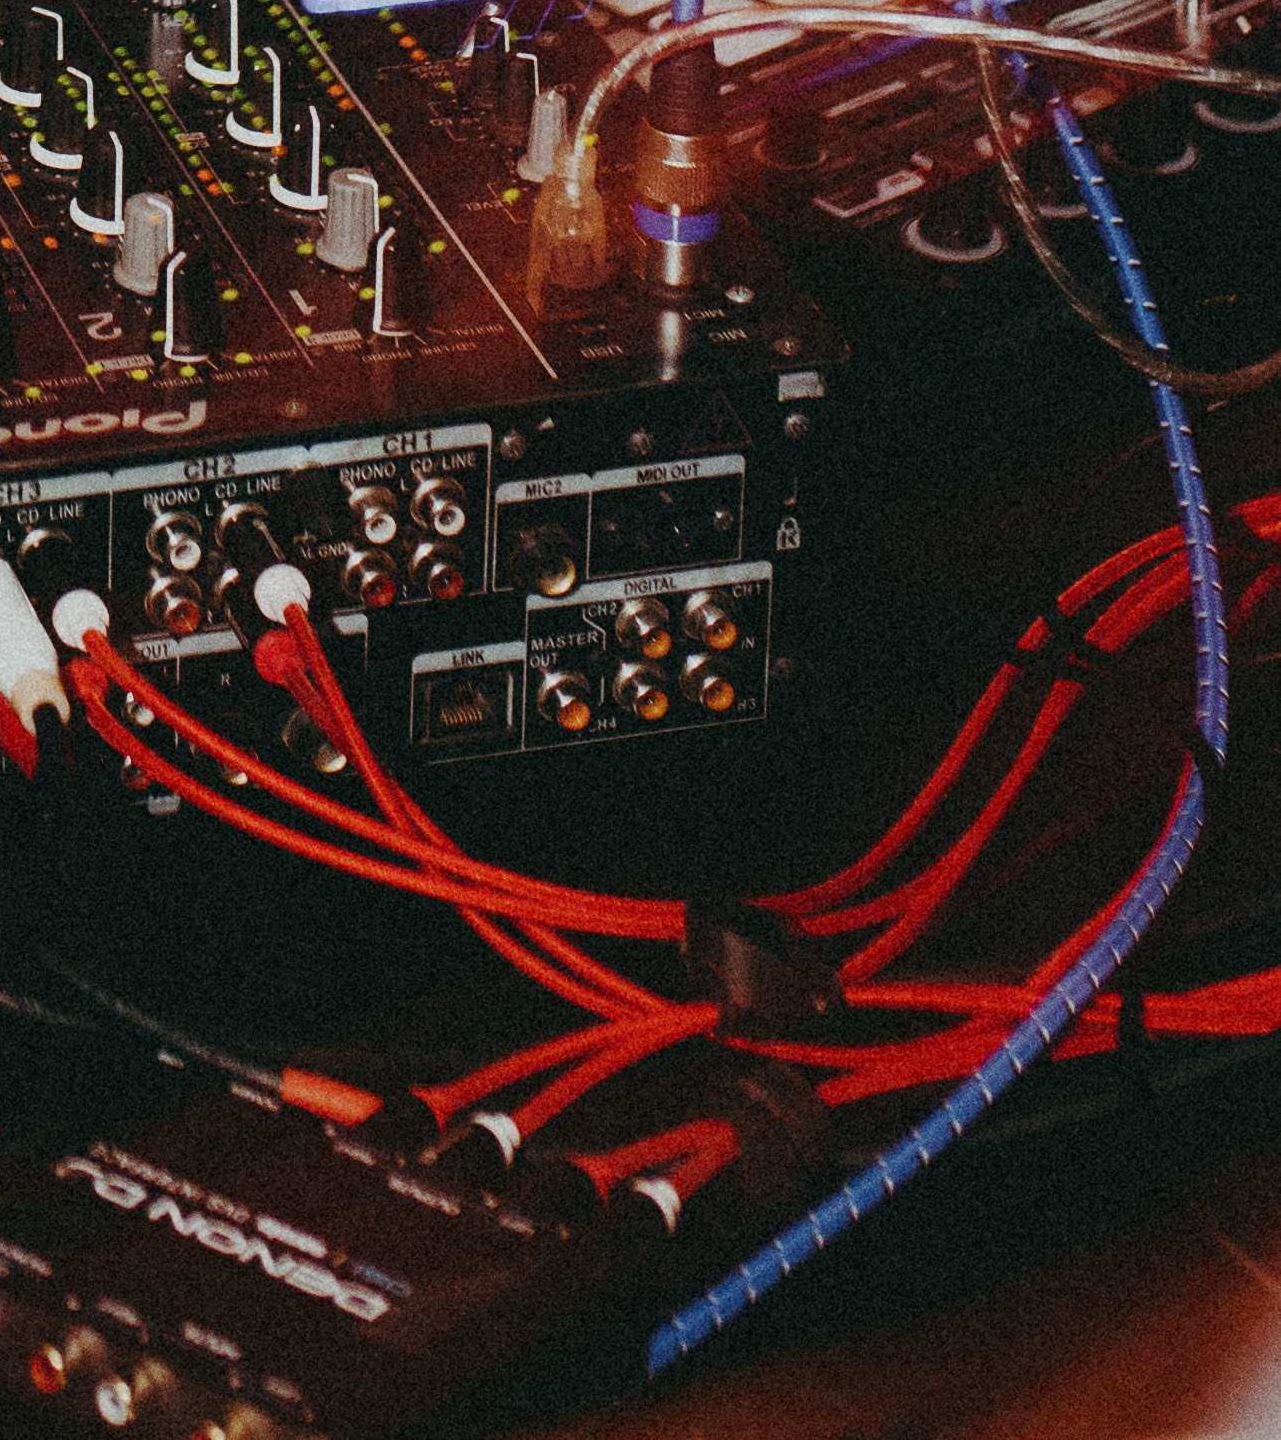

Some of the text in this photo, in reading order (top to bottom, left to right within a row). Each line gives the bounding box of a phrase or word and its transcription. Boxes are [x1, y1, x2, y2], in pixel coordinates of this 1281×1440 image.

[288, 288, 318, 316] 1
[77, 311, 123, 341] 2
[579, 344, 624, 360] USB
[339, 451, 478, 483] PHONO CD LINE
[636, 462, 702, 484] MIDI OUT
[142, 474, 282, 510] PHONO CD LINE
[16, 508, 40, 526] CD
[48, 501, 86, 521] LINE
[623, 576, 678, 596] DIGITAL
[530, 630, 600, 652] MASTER
[452, 649, 485, 667] LINK
[529, 652, 559, 668] OUT
[148, 1196, 390, 1324] DENON
